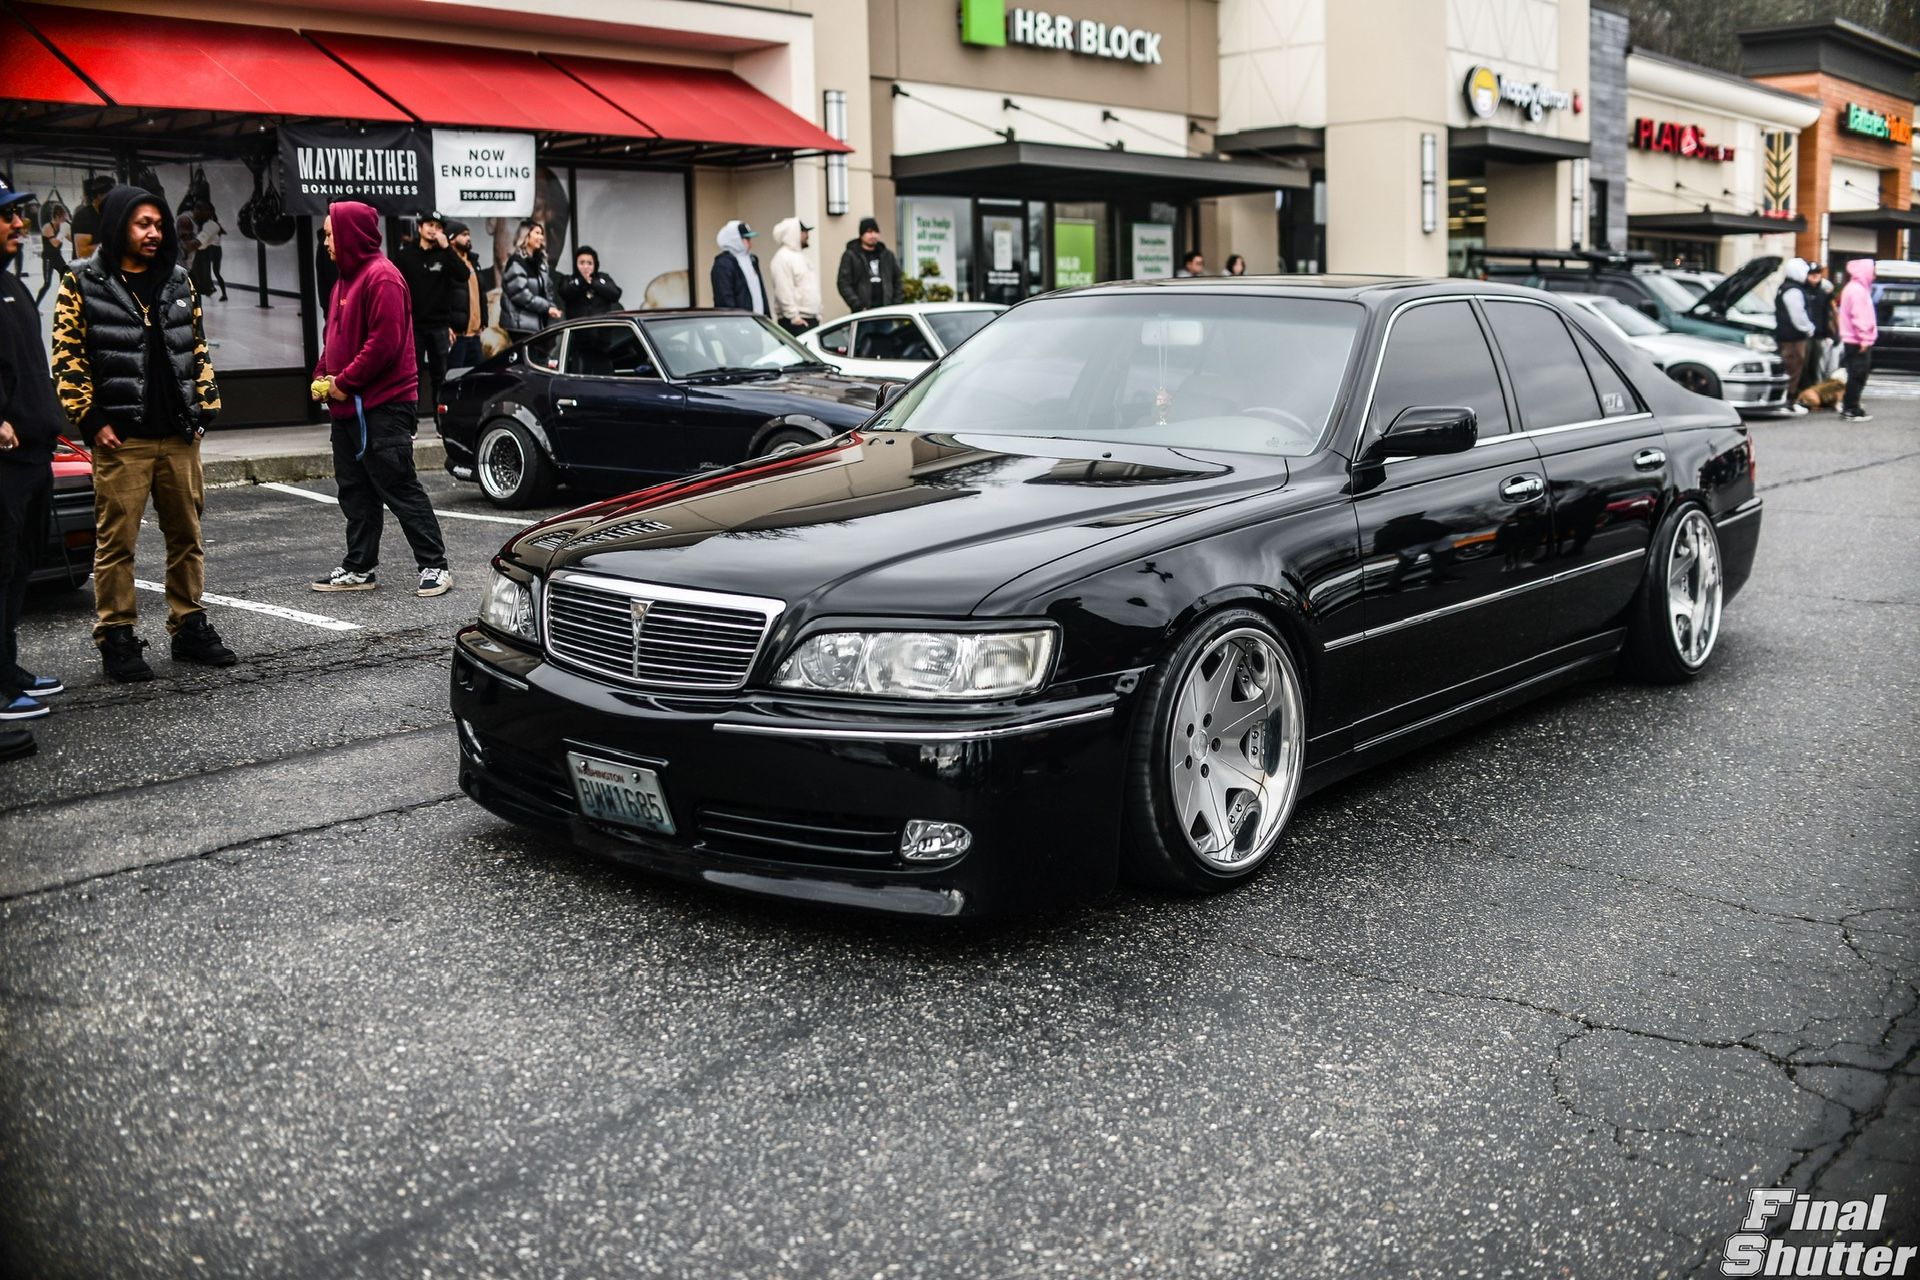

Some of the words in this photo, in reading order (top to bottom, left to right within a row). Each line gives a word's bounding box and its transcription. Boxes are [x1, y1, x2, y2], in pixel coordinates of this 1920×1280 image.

[1013, 8, 1074, 50] H&R
[1079, 19, 1162, 65] BLOCK
[297, 147, 419, 182] MAYWEATHER
[468, 149, 505, 162] NOW
[440, 164, 531, 179] ENROLLING
